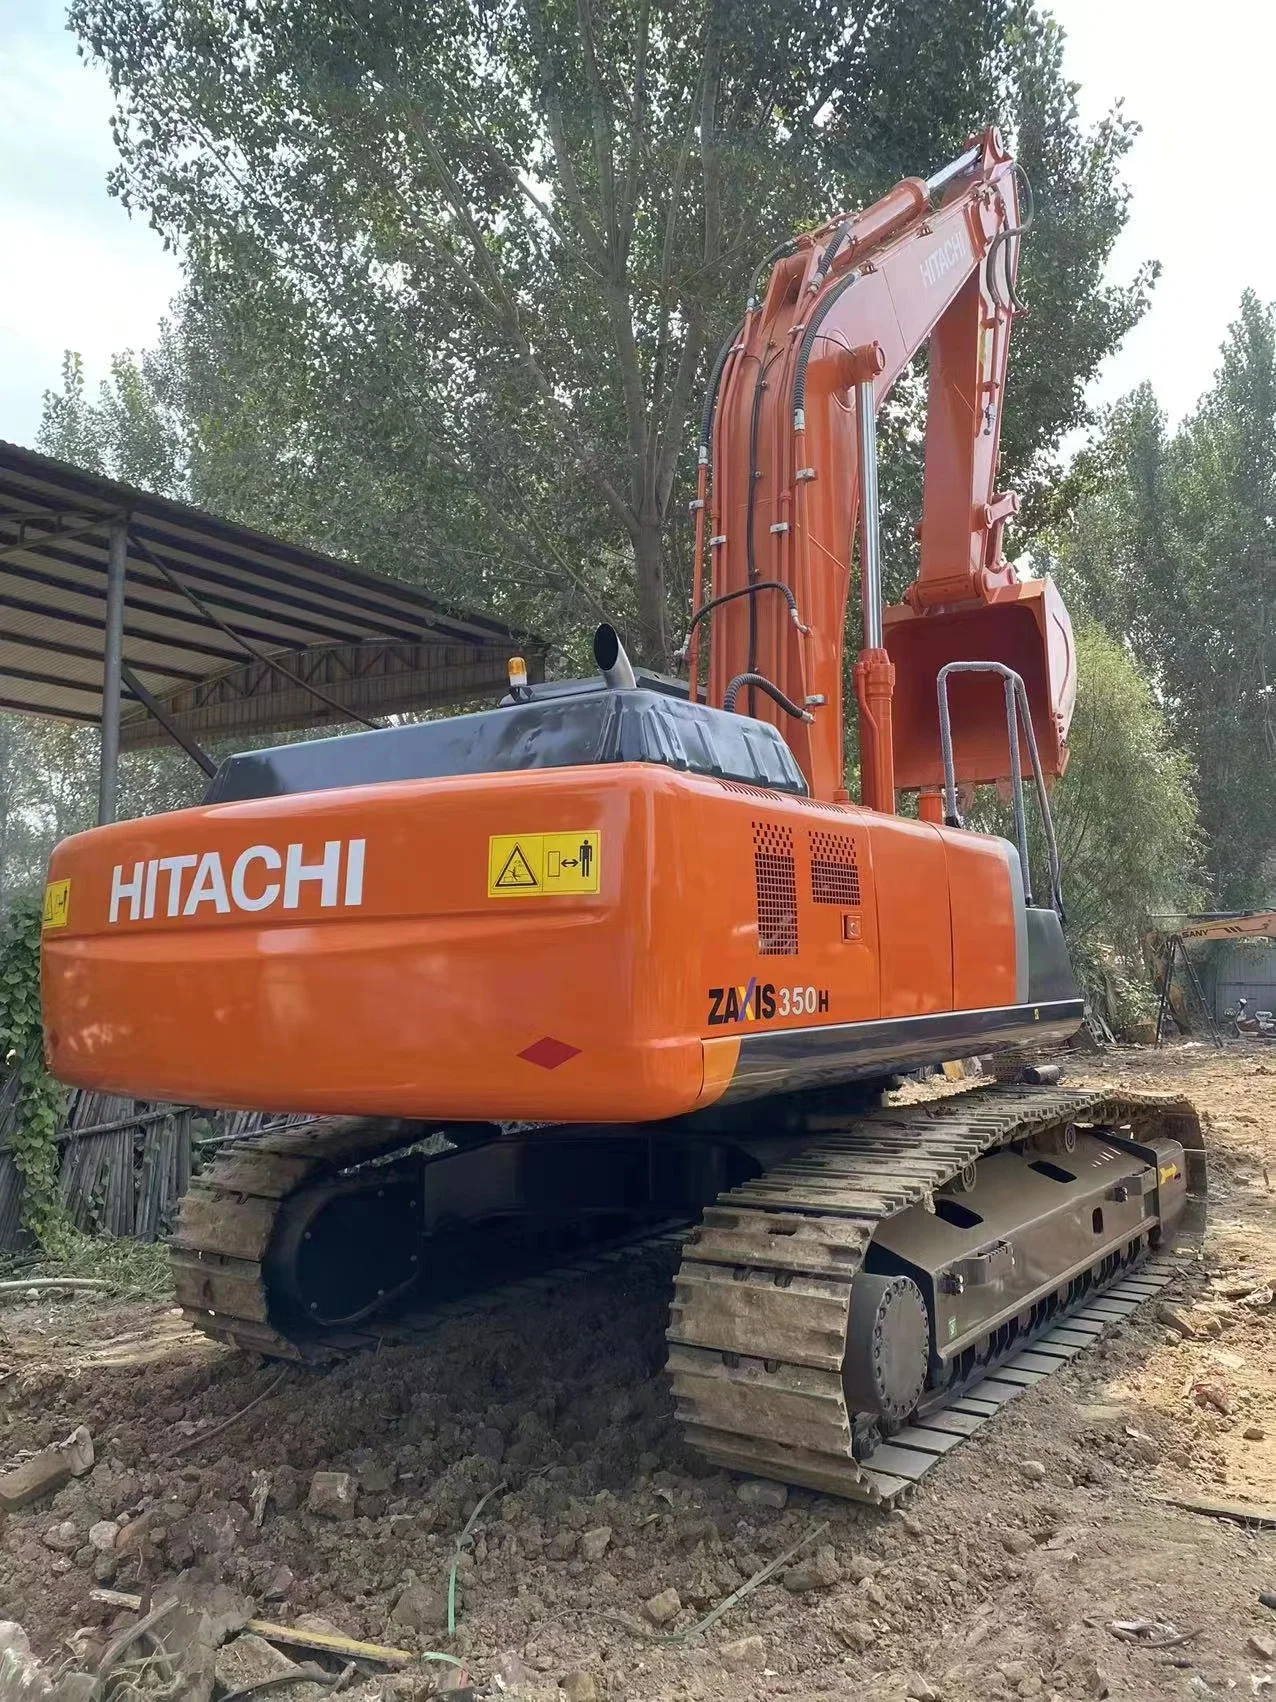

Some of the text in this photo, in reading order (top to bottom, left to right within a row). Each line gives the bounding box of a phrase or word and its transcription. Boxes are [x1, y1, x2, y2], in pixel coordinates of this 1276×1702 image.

[919, 231, 966, 288] HITACHI
[109, 838, 366, 923] HITACHI
[1181, 929, 1208, 938] SANY
[708, 977, 776, 1025] ZAXIS
